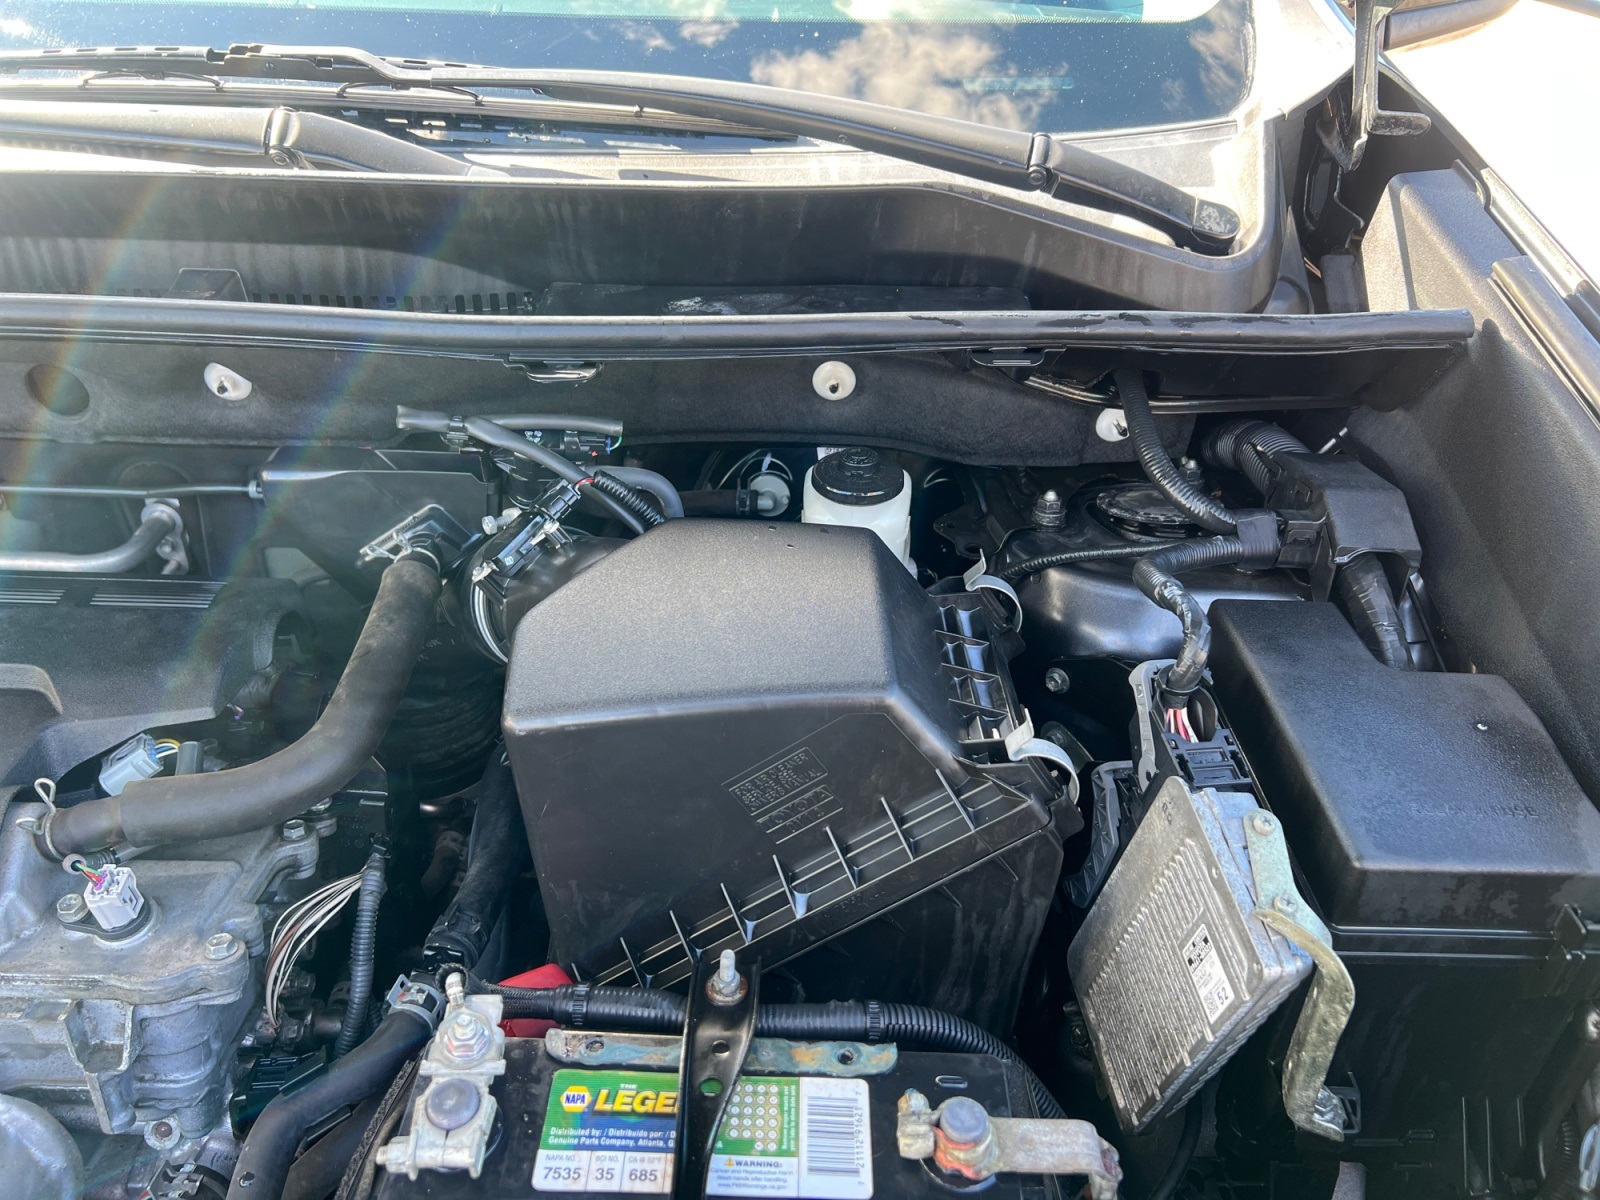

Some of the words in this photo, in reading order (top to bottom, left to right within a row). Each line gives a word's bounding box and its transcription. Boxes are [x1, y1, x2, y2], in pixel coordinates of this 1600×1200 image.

[735, 783, 753, 797] FOR
[755, 774, 769, 785] AIR
[769, 753, 808, 778] CLEANER
[777, 770, 797, 783] SEE
[758, 787, 833, 827] TOYOTA
[1217, 987, 1228, 1005] 52
[564, 1093, 586, 1104] NAPA
[593, 1088, 678, 1113] LEGE
[854, 1107, 863, 1135] 91621
[550, 1127, 589, 1136] Distributed
[548, 1136, 578, 1145] Genuine
[580, 1137, 599, 1145] Parts
[735, 1160, 783, 1168] WARNING:
[543, 1166, 582, 1181] 7535
[595, 1167, 615, 1181] 35
[629, 1168, 658, 1182] 685
